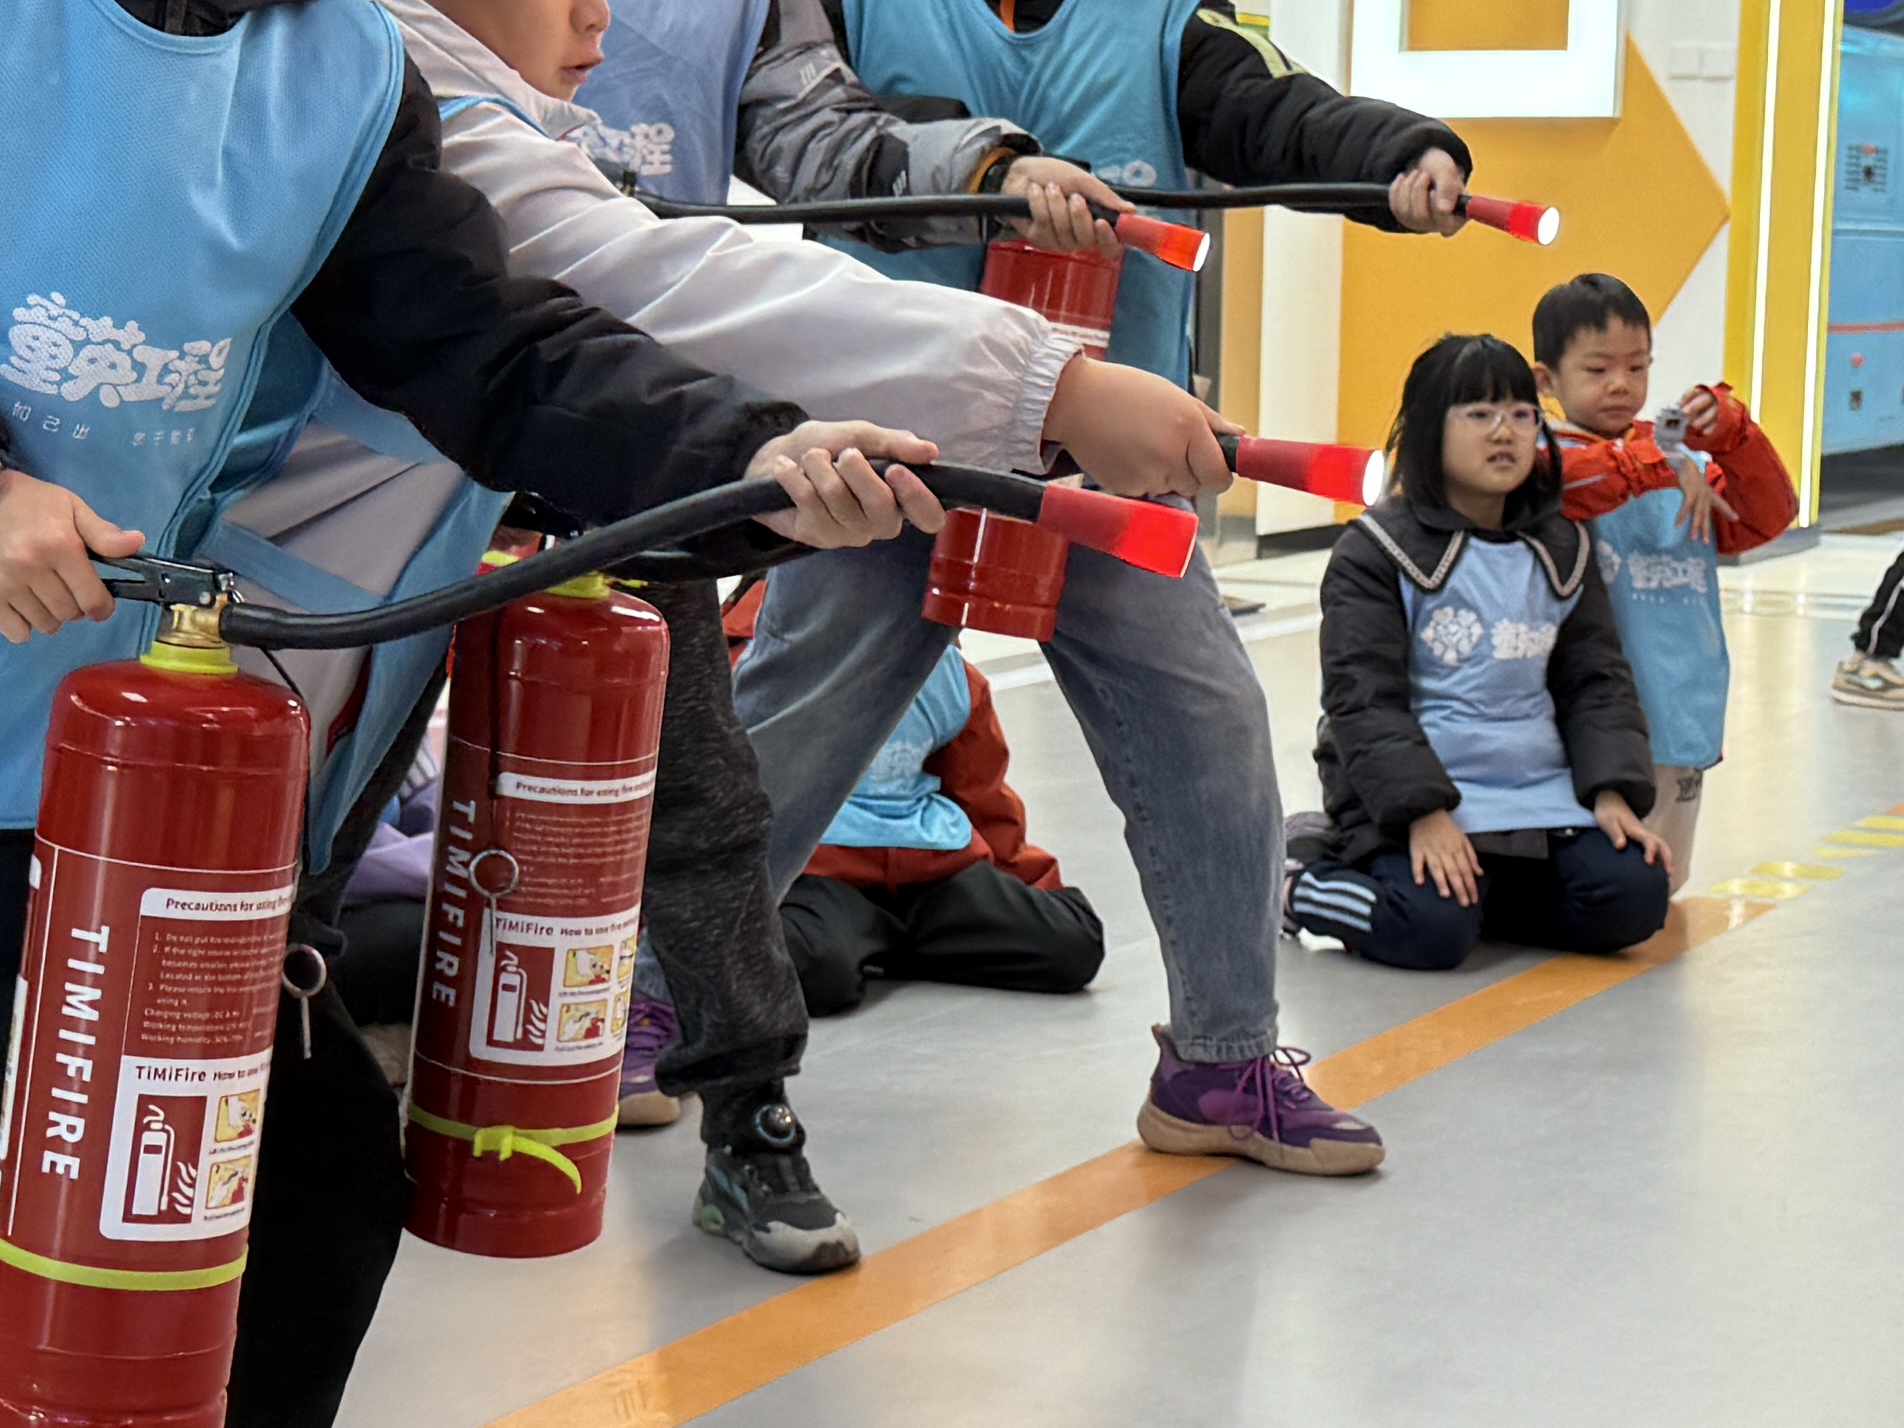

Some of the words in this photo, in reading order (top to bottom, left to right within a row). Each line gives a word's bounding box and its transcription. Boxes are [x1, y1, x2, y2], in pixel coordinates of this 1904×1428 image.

[165, 897, 238, 912] Precautions
[432, 799, 477, 1009] TIMIFIRE
[41, 925, 110, 1181] TIMIFIRE
[135, 1065, 207, 1082] TiMiFire
